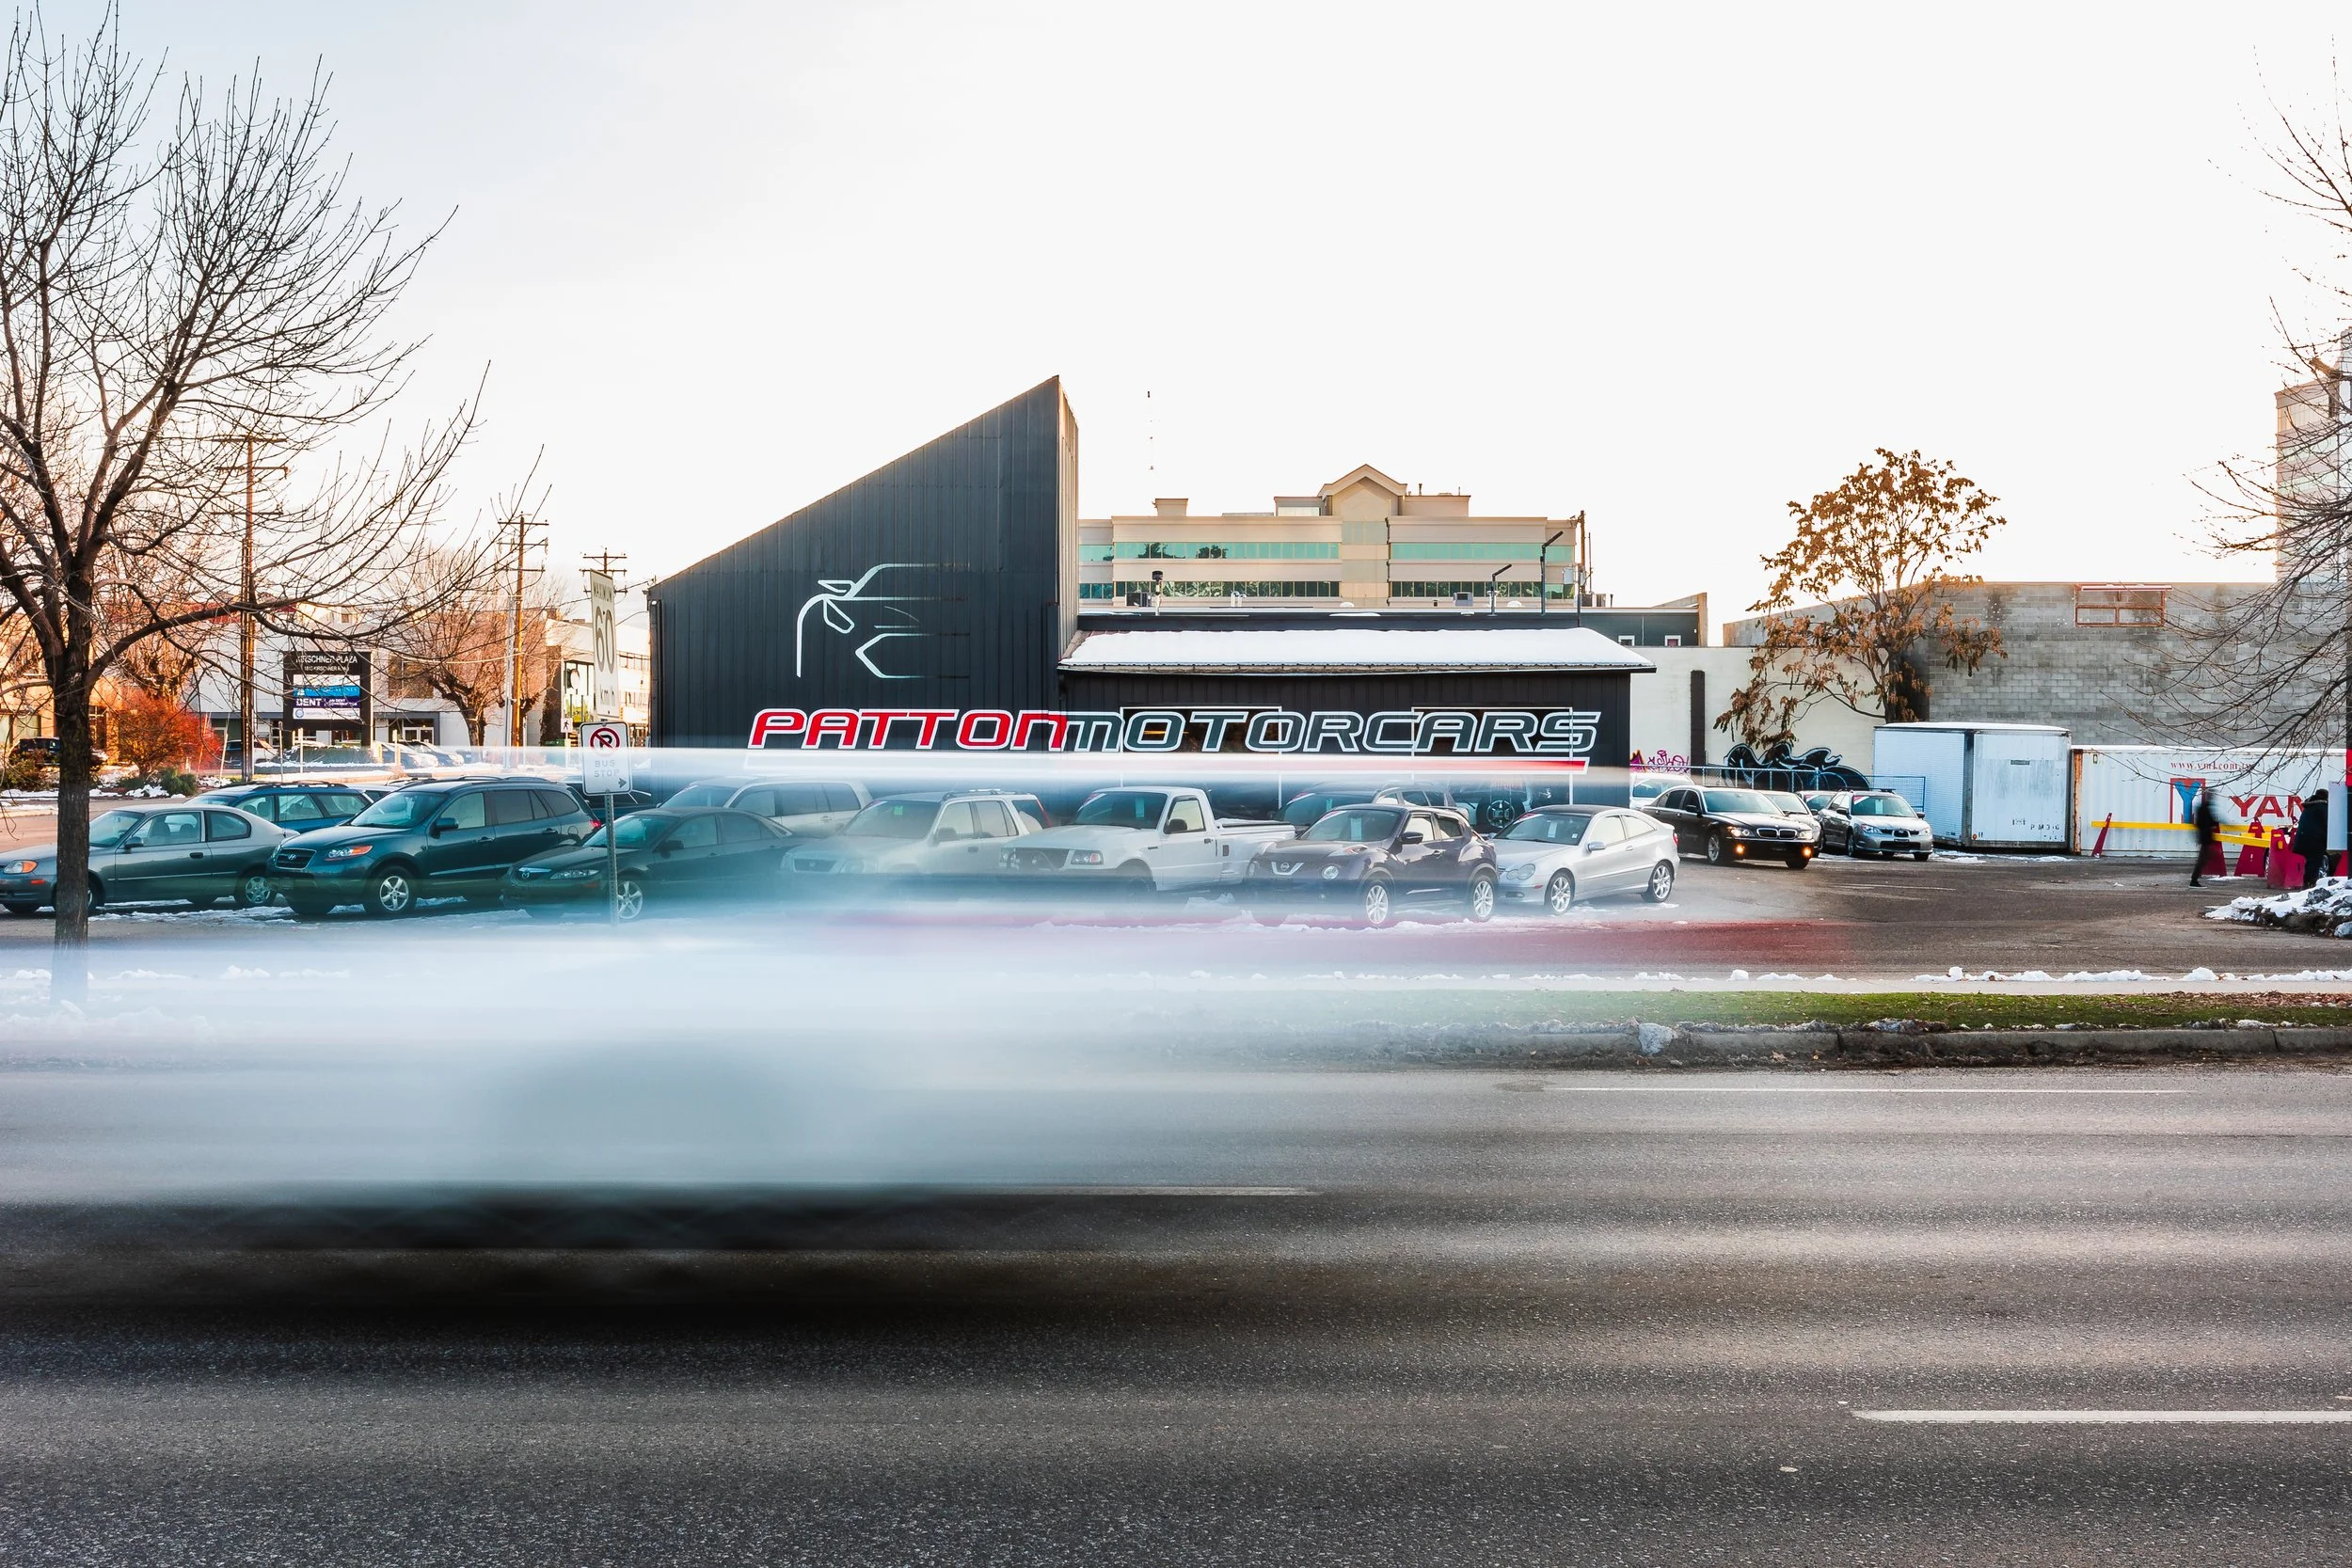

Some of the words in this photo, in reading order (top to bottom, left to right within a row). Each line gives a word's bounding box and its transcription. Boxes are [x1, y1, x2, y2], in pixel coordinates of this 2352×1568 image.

[595, 606, 614, 674] 60
[337, 655, 358, 664] PLAZA
[295, 698, 323, 706] DENT
[747, 708, 1067, 751] PATTON
[1065, 710, 1601, 752] MOTORCARS
[594, 769, 619, 778] STOP
